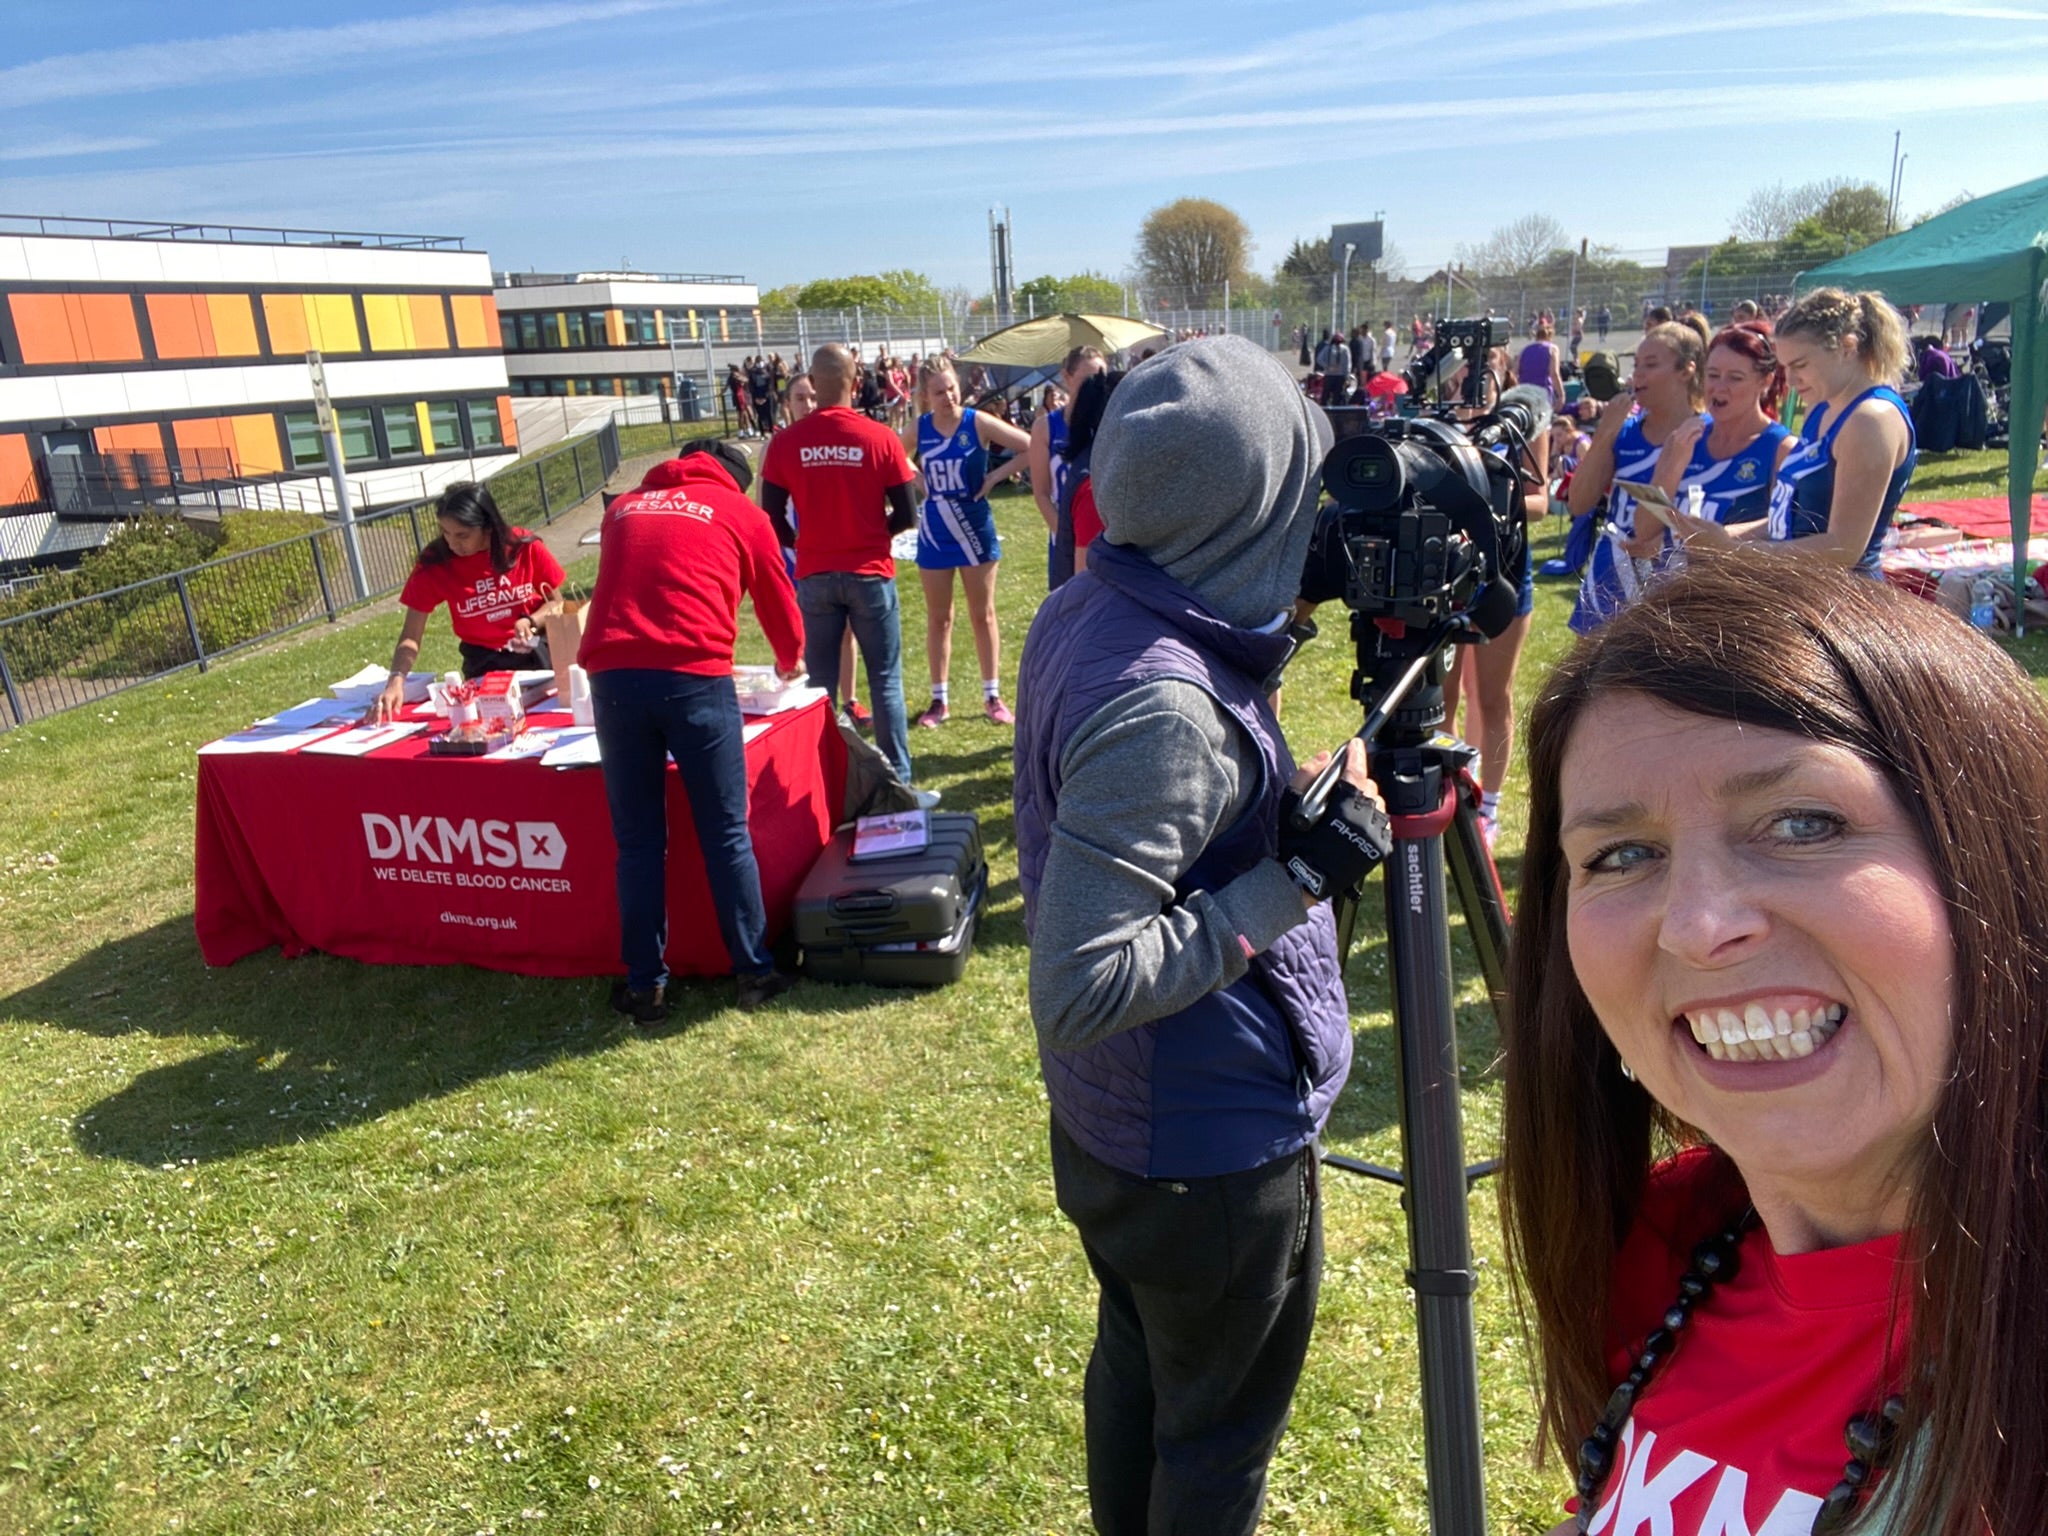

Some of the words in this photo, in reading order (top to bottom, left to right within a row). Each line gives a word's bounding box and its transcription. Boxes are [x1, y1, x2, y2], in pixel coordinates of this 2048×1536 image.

[800, 446, 848, 462] DKMS
[929, 458, 965, 492] GK
[643, 491, 669, 501] BE
[672, 490, 687, 501] A
[615, 500, 714, 520] LIFESAVER
[457, 582, 533, 613] LIFESAVER
[476, 577, 497, 594] BE
[500, 575, 512, 587] A
[361, 813, 517, 869] DKMS
[1330, 818, 1381, 860] AKASO
[373, 866, 398, 881] WE
[401, 868, 453, 886] DELETE
[456, 873, 507, 889] BLOOD
[510, 876, 572, 893] CANCER
[1408, 844, 1425, 915] sachtler
[440, 911, 518, 930] dkms.org.uk
